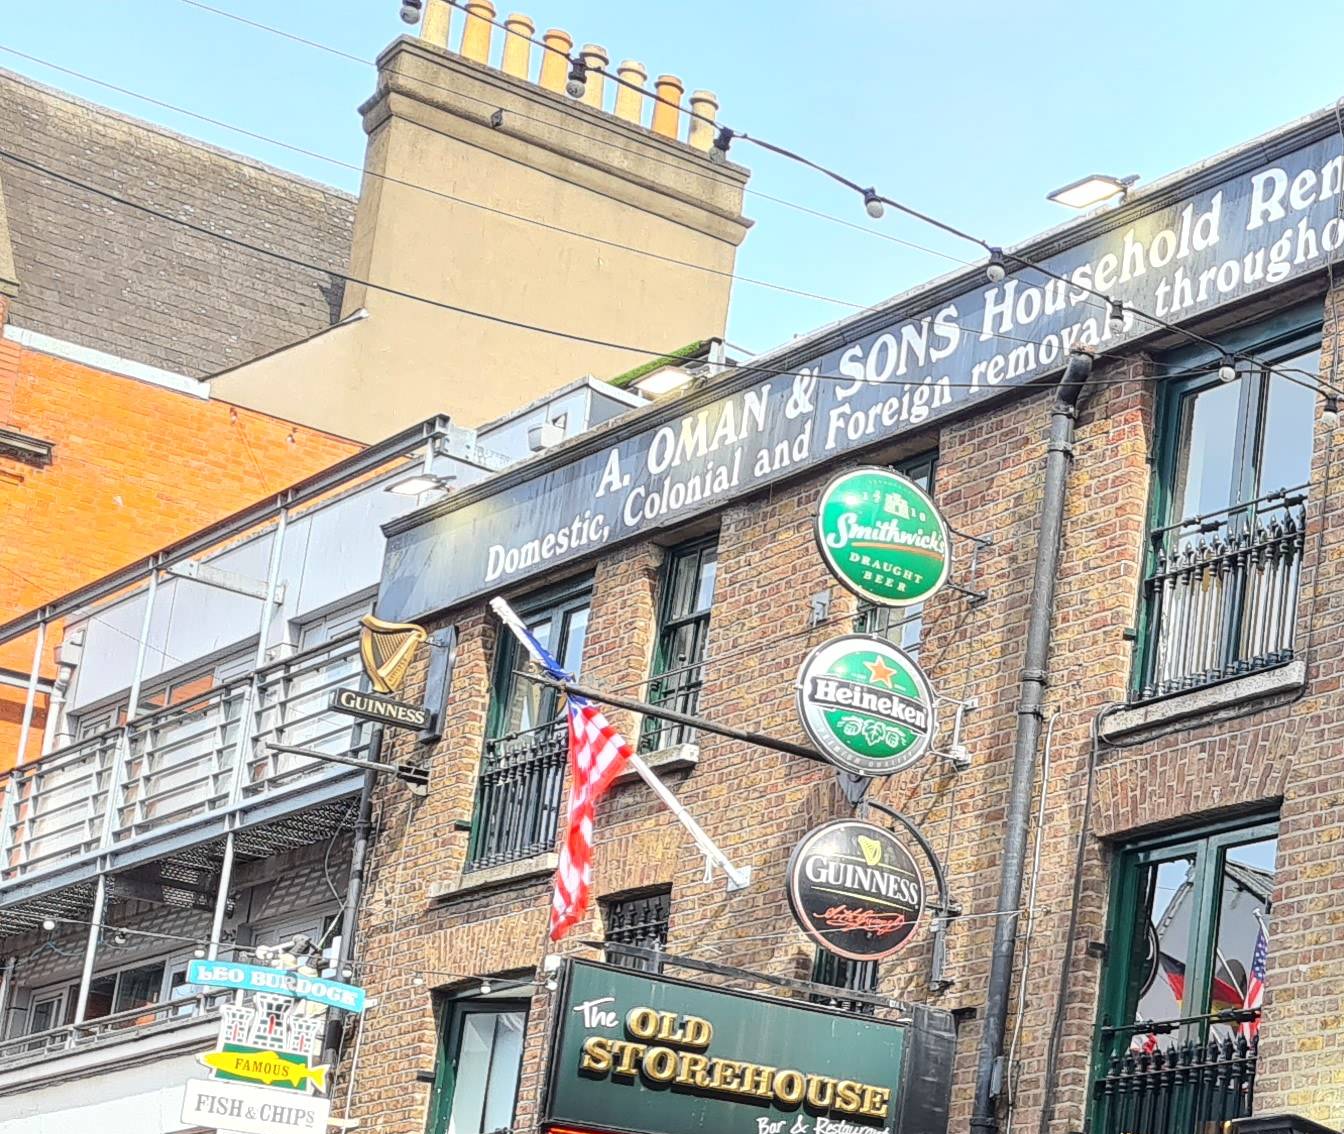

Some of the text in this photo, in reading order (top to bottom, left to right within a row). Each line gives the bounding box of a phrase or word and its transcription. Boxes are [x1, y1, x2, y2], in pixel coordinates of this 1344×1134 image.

[596, 446, 630, 497] A.
[645, 382, 772, 474] OMAN
[785, 363, 818, 420] &
[834, 304, 961, 402] SONS
[978, 191, 1224, 342] Household
[484, 516, 611, 584] Domestic,
[623, 463, 740, 528] Colonial
[752, 425, 811, 477] and
[824, 371, 952, 451] Foreign
[826, 511, 946, 554] Smithwick's
[849, 552, 924, 585] DRAUGHT
[862, 570, 907, 593] BEER
[340, 691, 426, 725] GUINNESS
[814, 677, 929, 730] Heineken
[805, 854, 919, 906] GUINNESS
[572, 996, 713, 1048] The OLD
[234, 1057, 290, 1077] FAMOUS
[579, 1036, 892, 1119] STOREHOUSE
[194, 1094, 315, 1128] FISH & CHIPS
